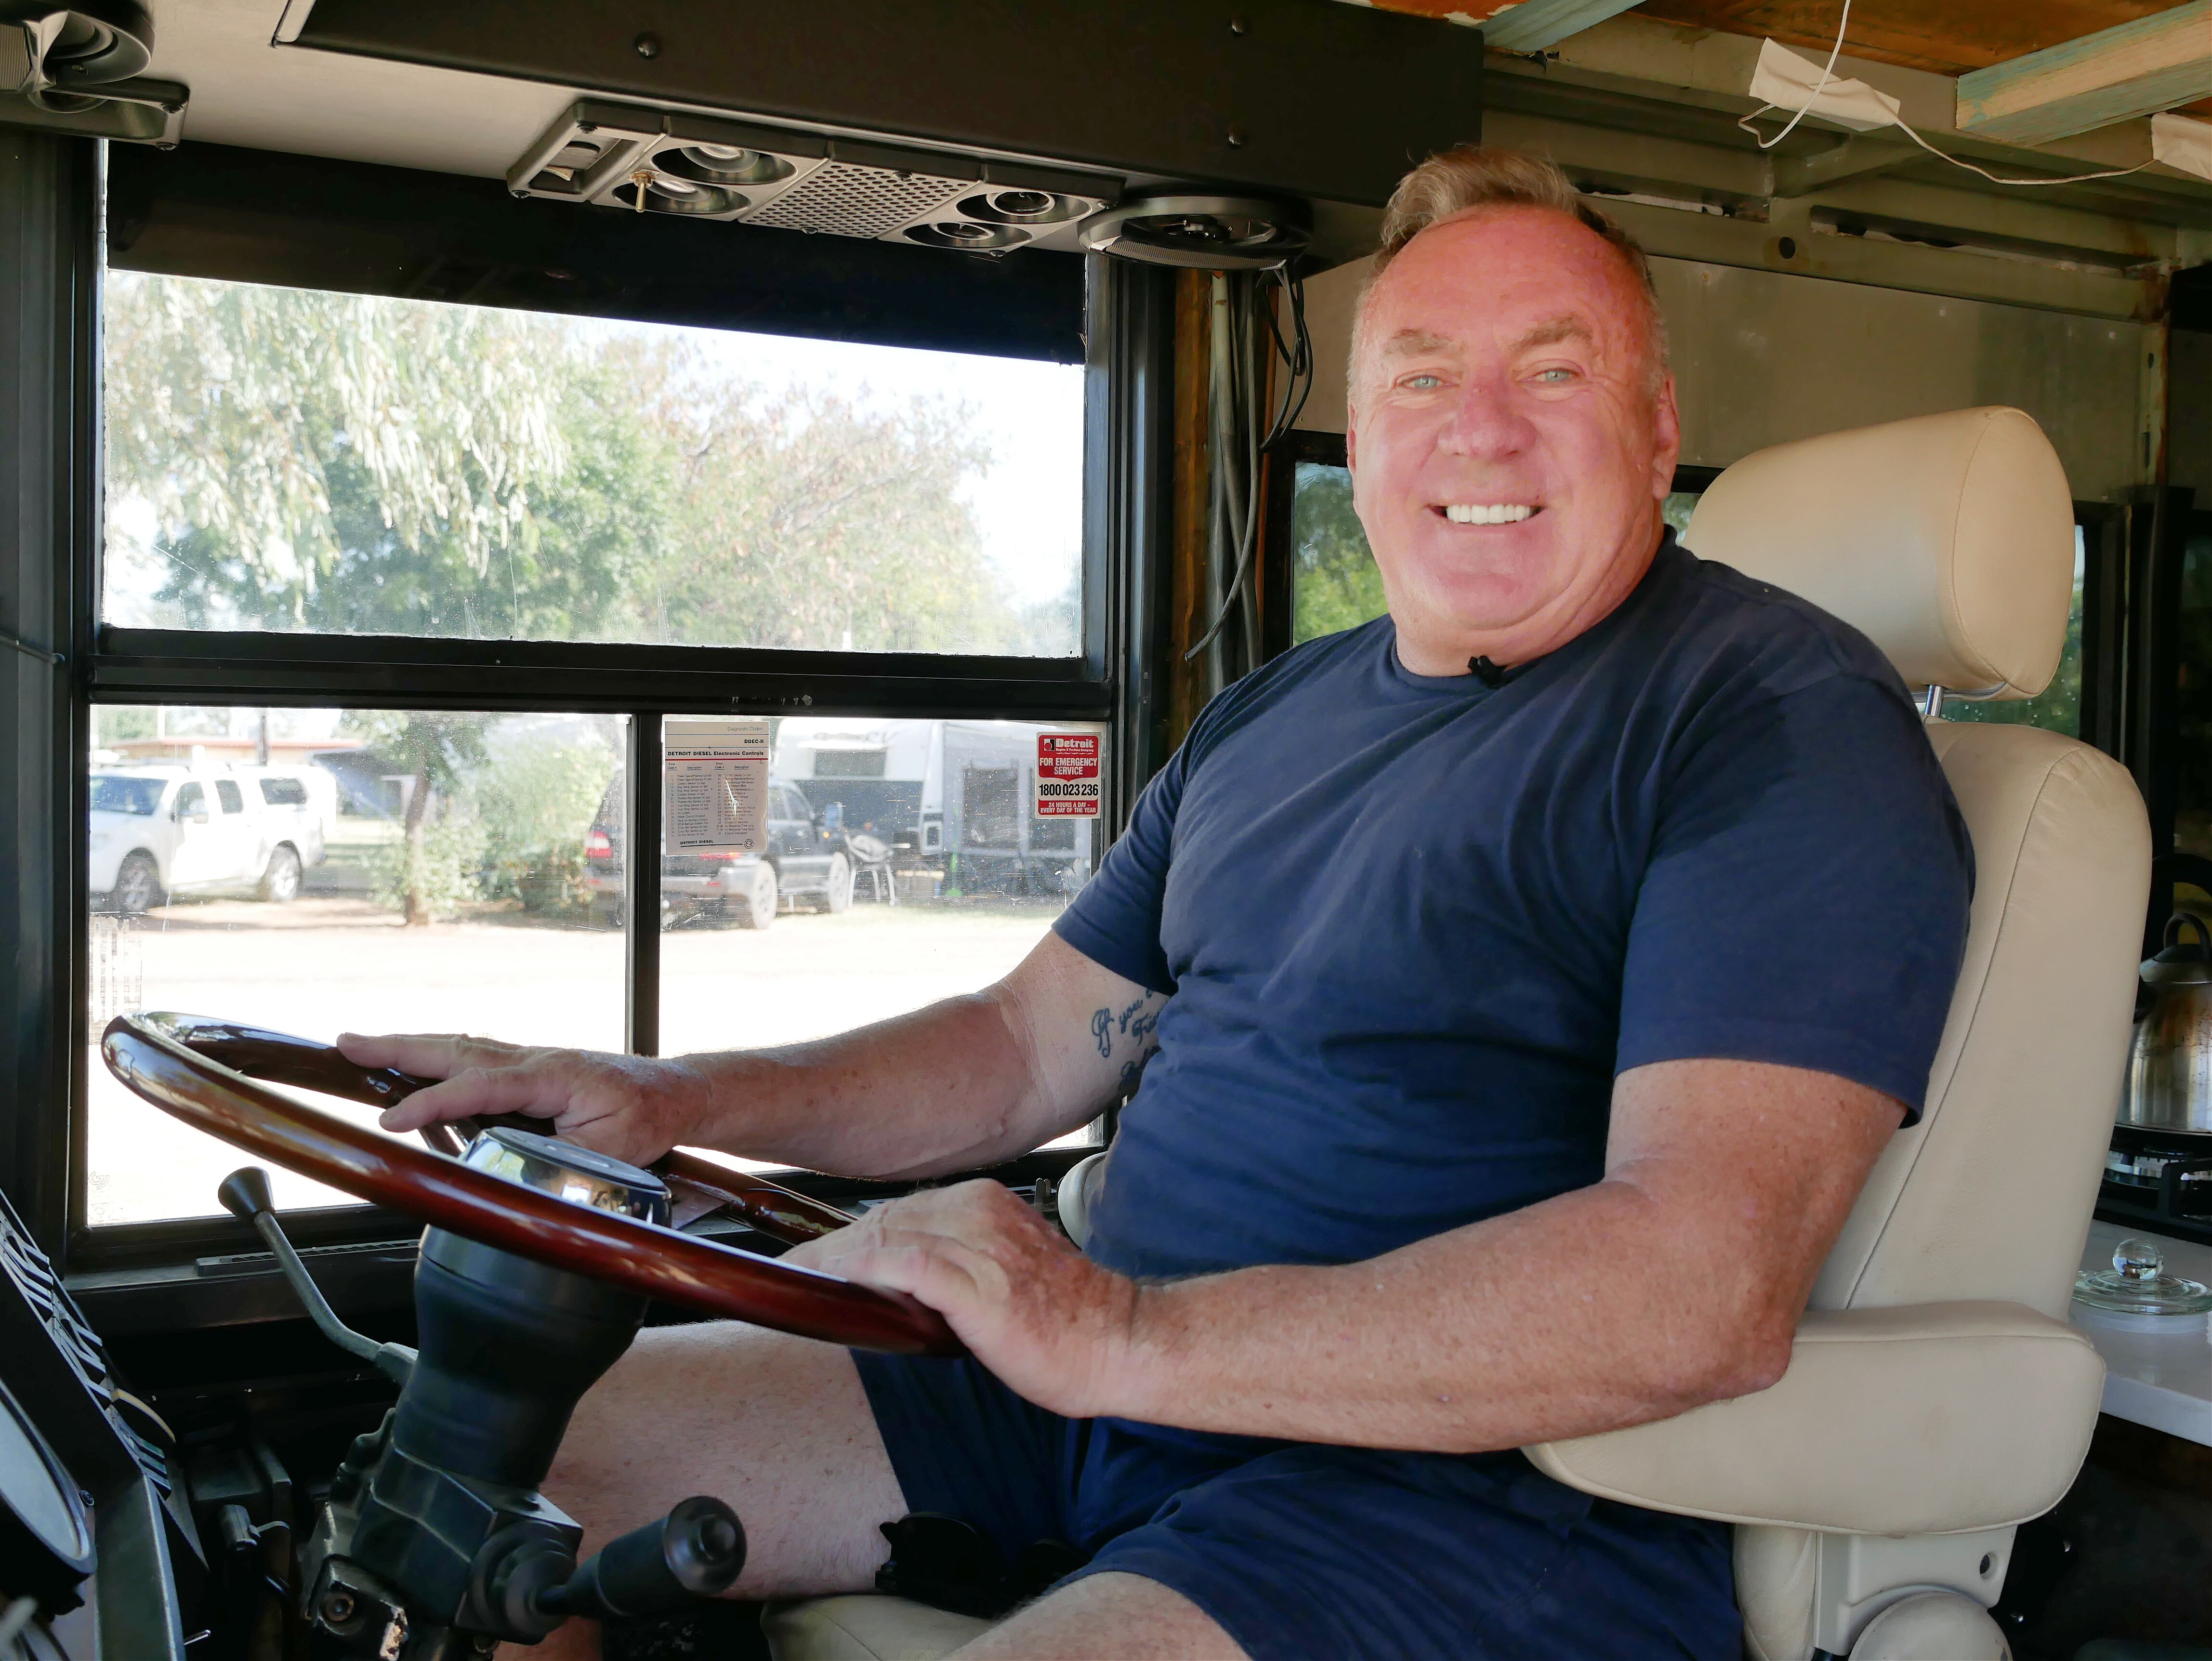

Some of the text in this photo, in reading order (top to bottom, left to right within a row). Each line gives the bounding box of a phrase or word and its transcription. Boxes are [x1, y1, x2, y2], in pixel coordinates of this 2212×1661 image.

[1056, 738, 1094, 748] Detroit
[1040, 758, 1097, 766] FOR EMERGENCY
[1054, 766, 1083, 775] SERVICE
[1039, 784, 1098, 796] 1800 023 236
